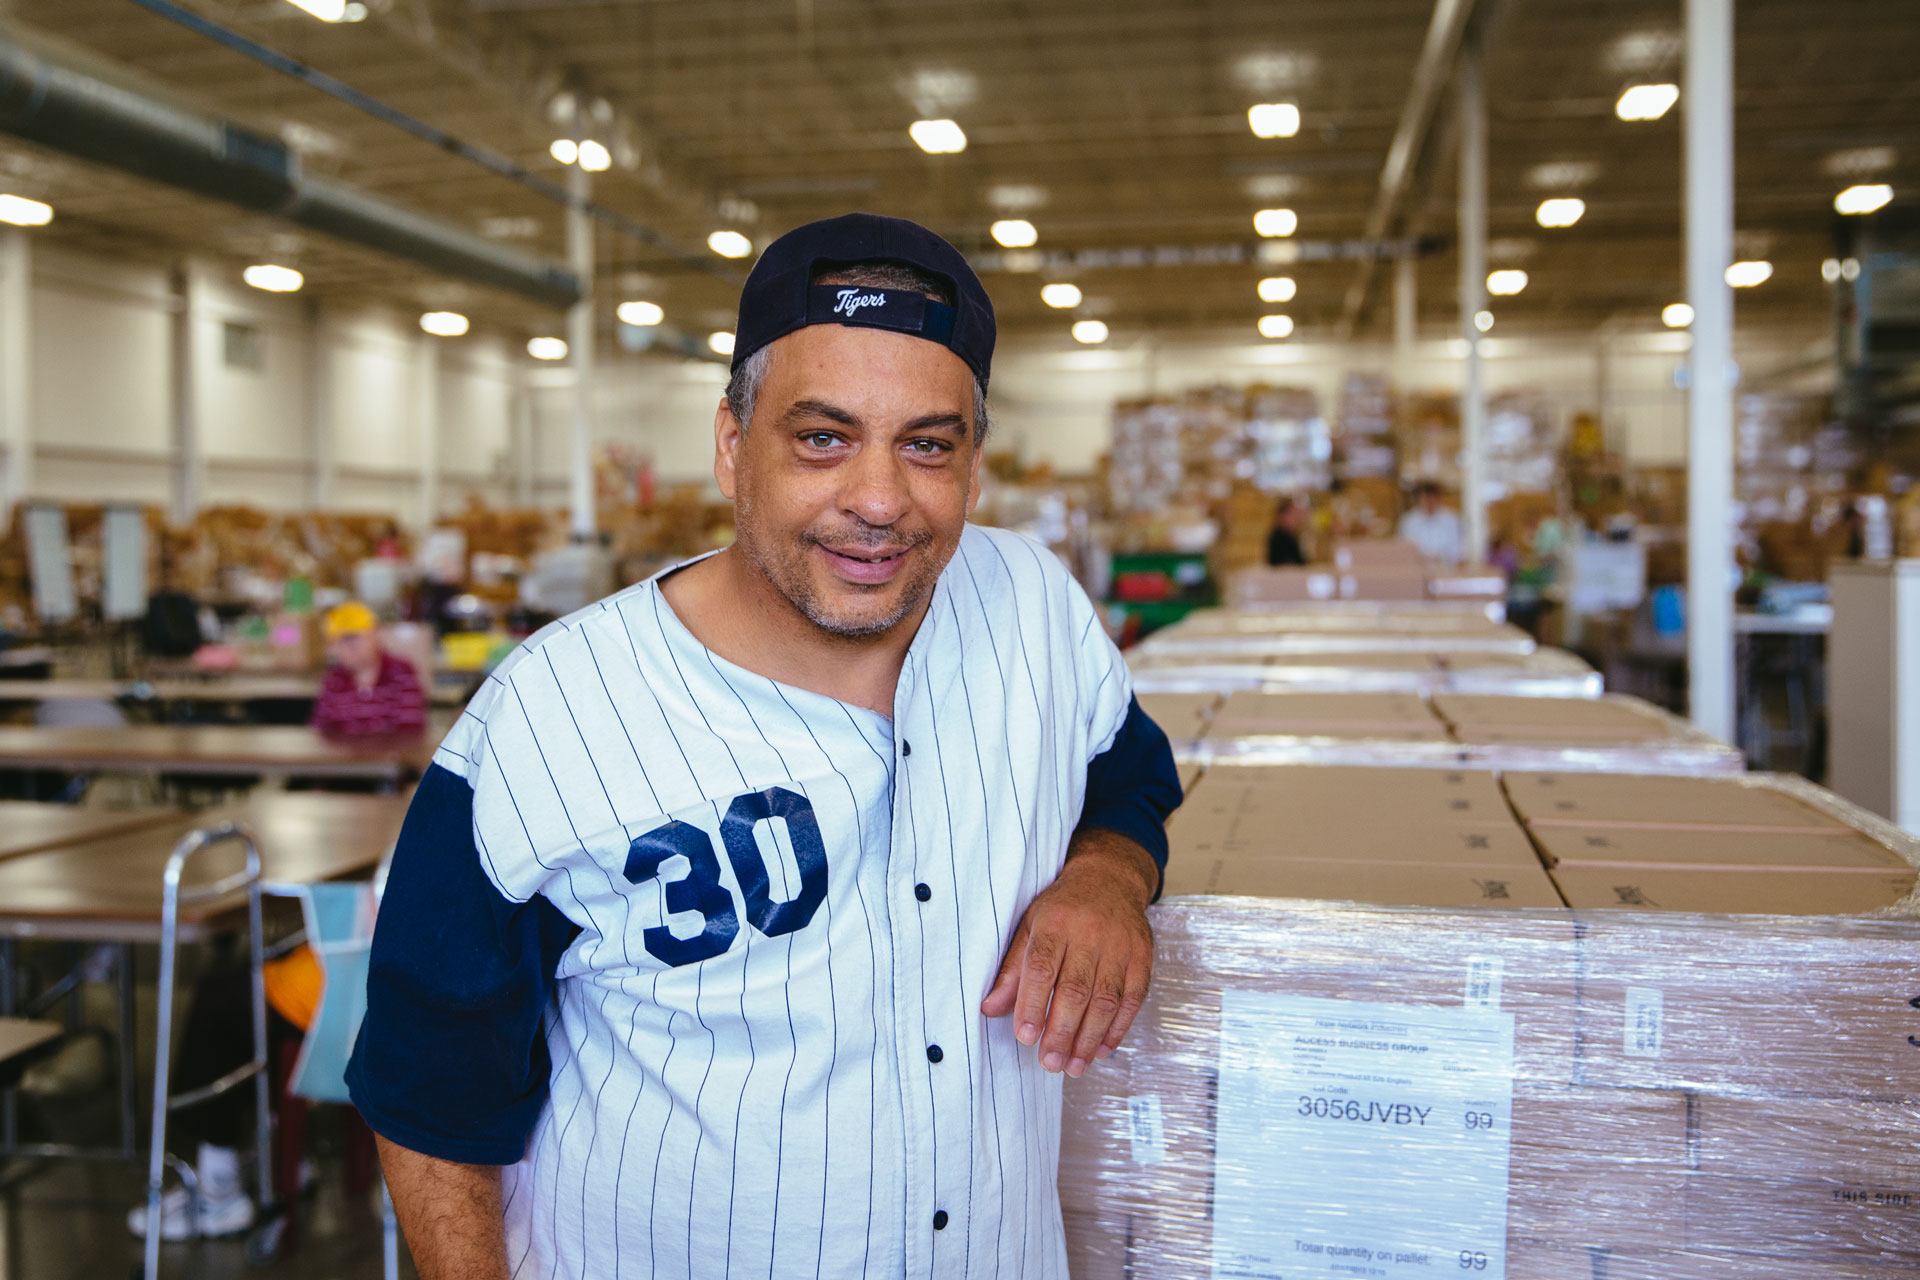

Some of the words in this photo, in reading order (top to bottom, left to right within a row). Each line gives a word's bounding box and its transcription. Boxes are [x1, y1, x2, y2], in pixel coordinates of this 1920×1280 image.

[833, 288, 887, 317] Tigers
[622, 785, 829, 968] 30
[1295, 1036, 1337, 1047] ACCESS
[1338, 1040, 1390, 1051] BUSINESS
[1391, 1043, 1429, 1054] GROUP
[1297, 1095, 1432, 1126] 3056JVBY
[1464, 1111, 1493, 1130] 99
[1832, 1190, 1868, 1203] THIS
[1875, 1192, 1912, 1206] SIDE
[1294, 1239, 1324, 1254] Total
[1326, 1244, 1374, 1262] quantity
[1377, 1251, 1393, 1261] on
[1395, 1252, 1432, 1266] pallet:
[1458, 1250, 1488, 1271] 99
